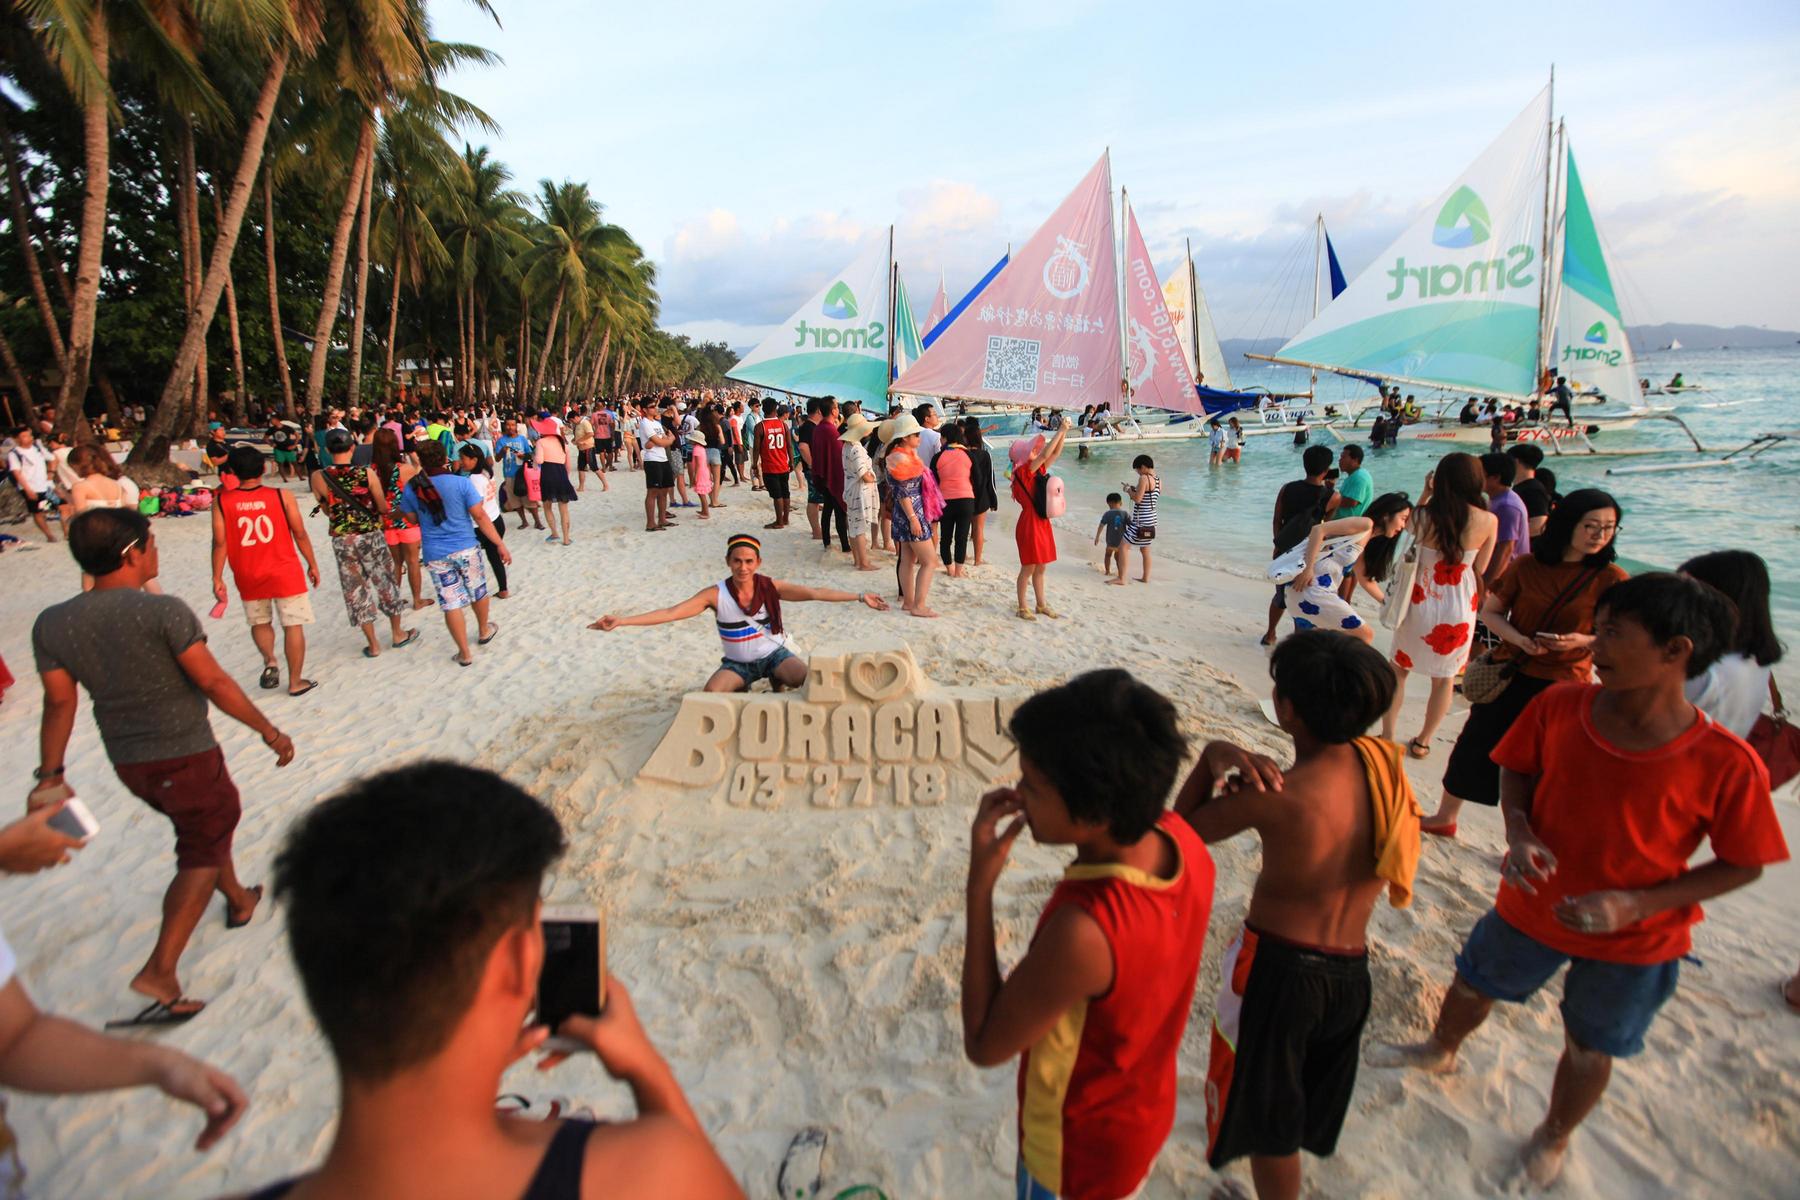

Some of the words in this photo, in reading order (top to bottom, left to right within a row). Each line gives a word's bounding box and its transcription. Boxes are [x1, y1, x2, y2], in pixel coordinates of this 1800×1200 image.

[767, 433, 789, 449] 20
[238, 514, 274, 547] 20
[809, 655, 848, 702] I
